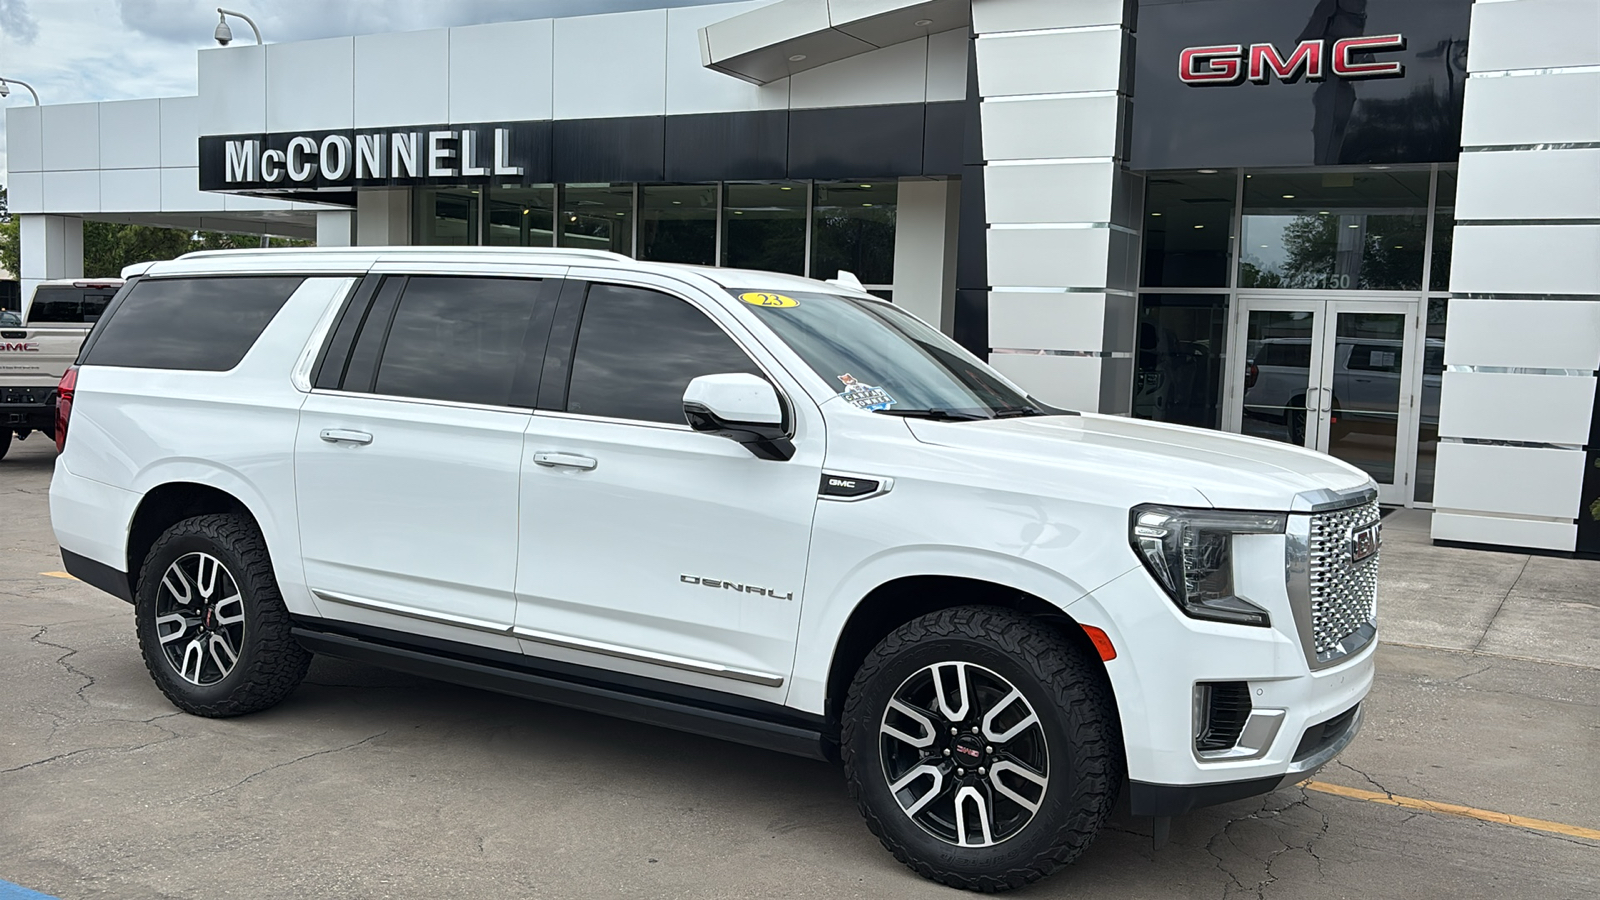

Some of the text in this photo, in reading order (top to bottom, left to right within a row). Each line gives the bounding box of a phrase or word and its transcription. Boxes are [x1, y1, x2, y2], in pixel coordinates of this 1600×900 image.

[1178, 33, 1404, 84] GMC
[224, 128, 524, 182] McCONNELL
[757, 293, 783, 306] 23
[828, 478, 856, 489] GMC
[680, 574, 793, 602] DENALI
